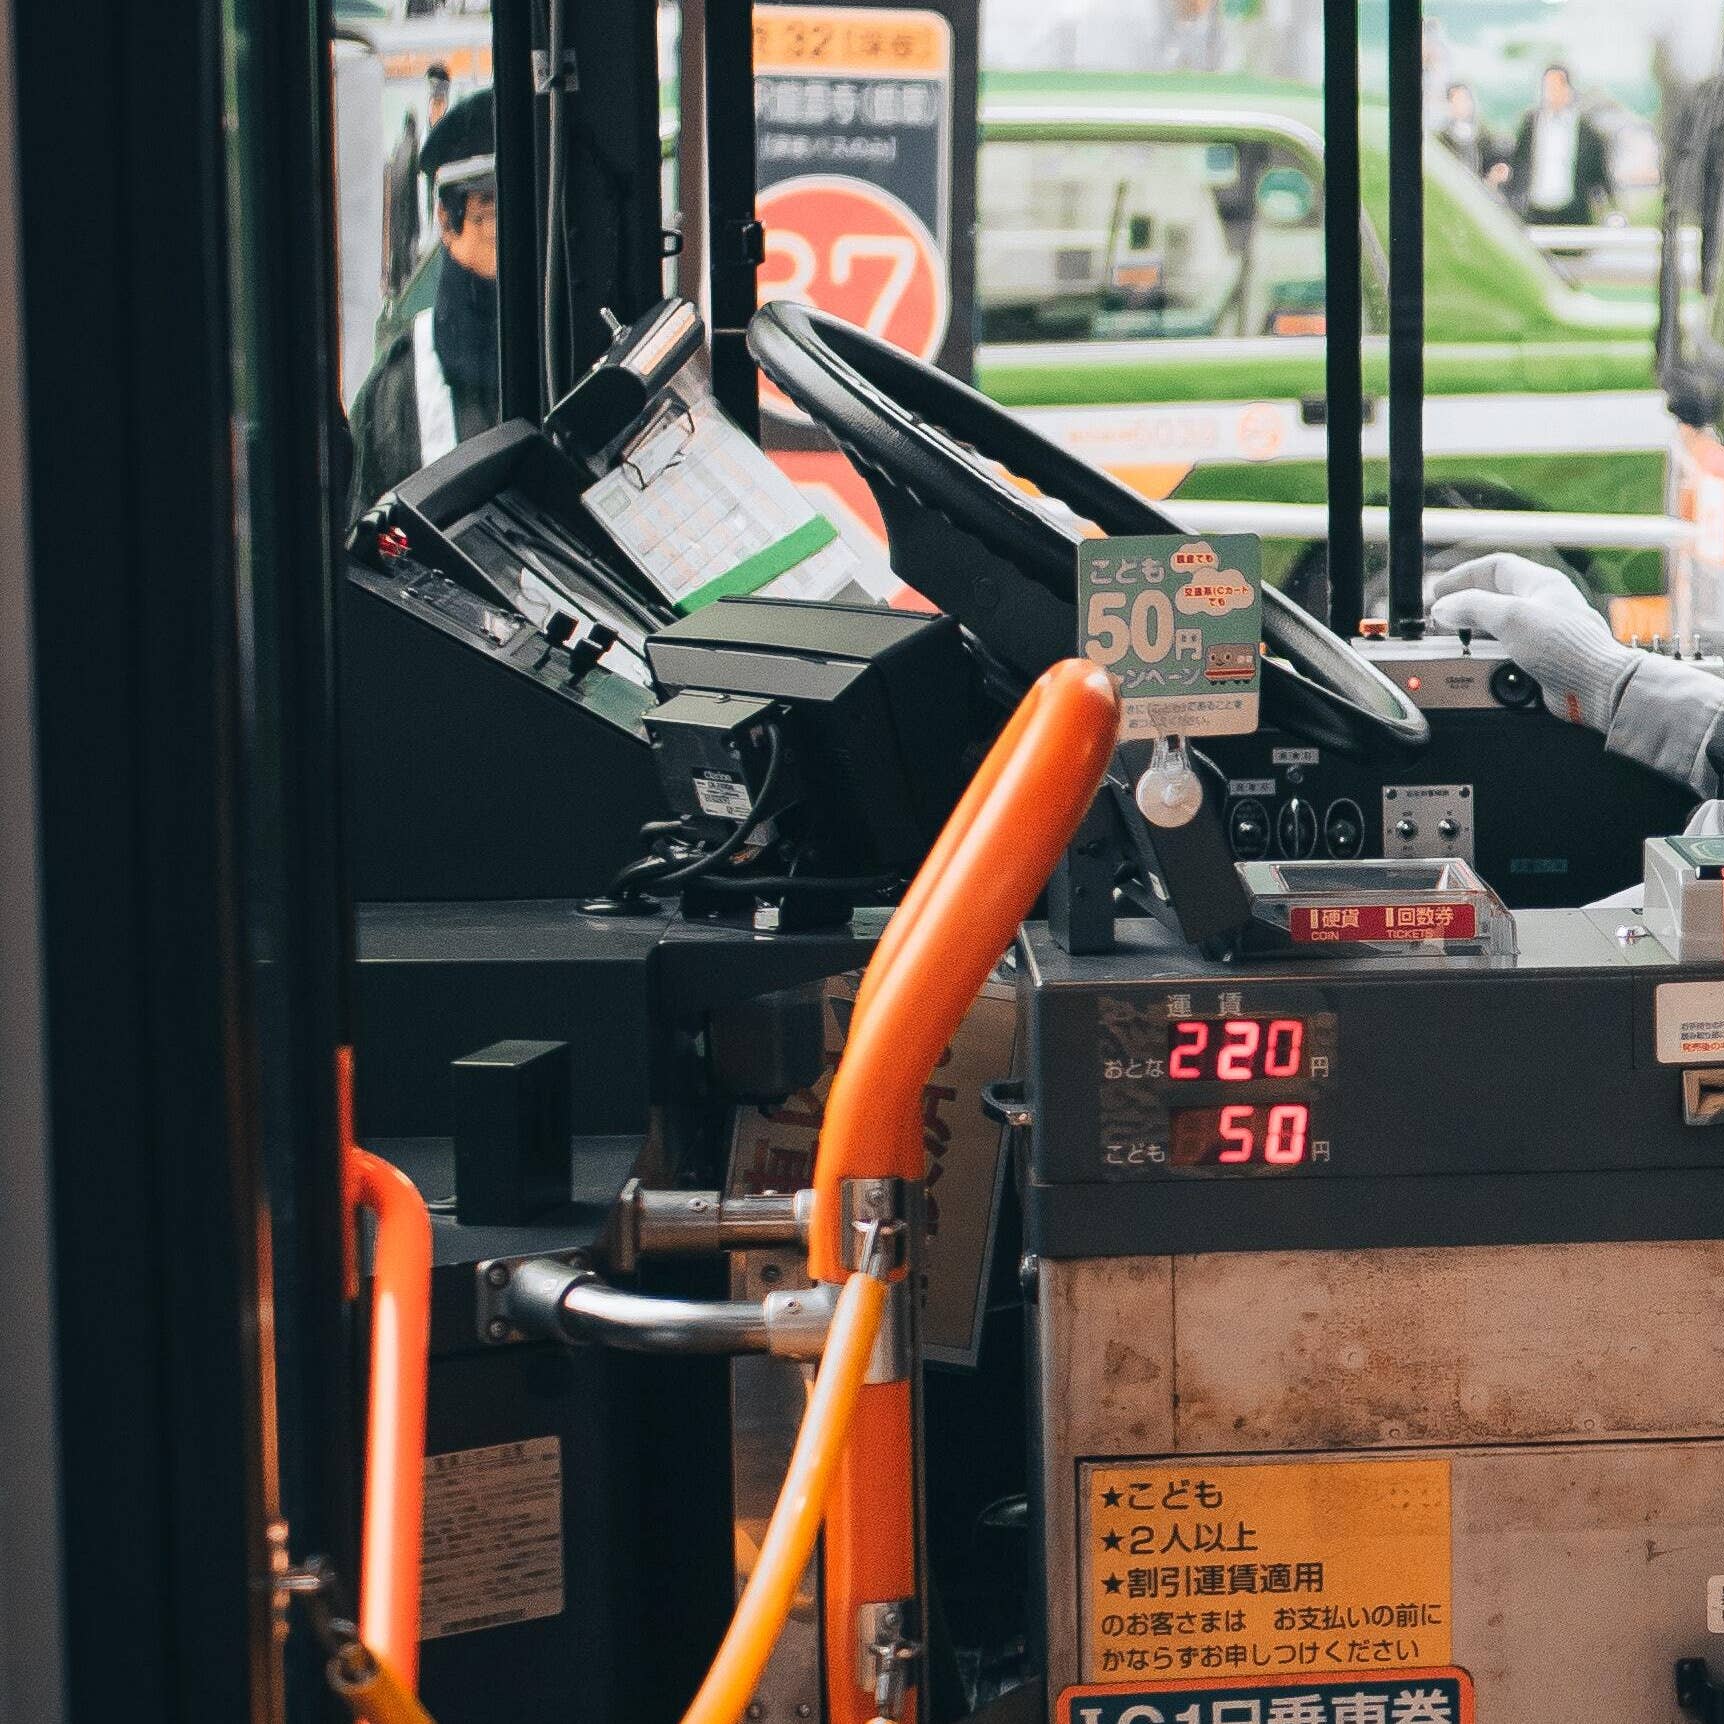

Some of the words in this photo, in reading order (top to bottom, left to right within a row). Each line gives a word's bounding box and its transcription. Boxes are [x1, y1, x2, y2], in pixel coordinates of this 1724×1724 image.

[1089, 558, 1166, 585] こども
[1397, 906, 1454, 928] 回数券
[1311, 930, 1340, 941] COIN
[1386, 928, 1434, 939] TICKETS
[1104, 1058, 1165, 1080] おとな
[1169, 1019, 1303, 1080] 220
[1310, 1055, 1330, 1078] 円
[1105, 1142, 1166, 1164] こども
[1218, 1104, 1309, 1164] 50
[1312, 1140, 1331, 1162] 円
[1101, 1638, 1420, 1672] かならずお申しつけください
